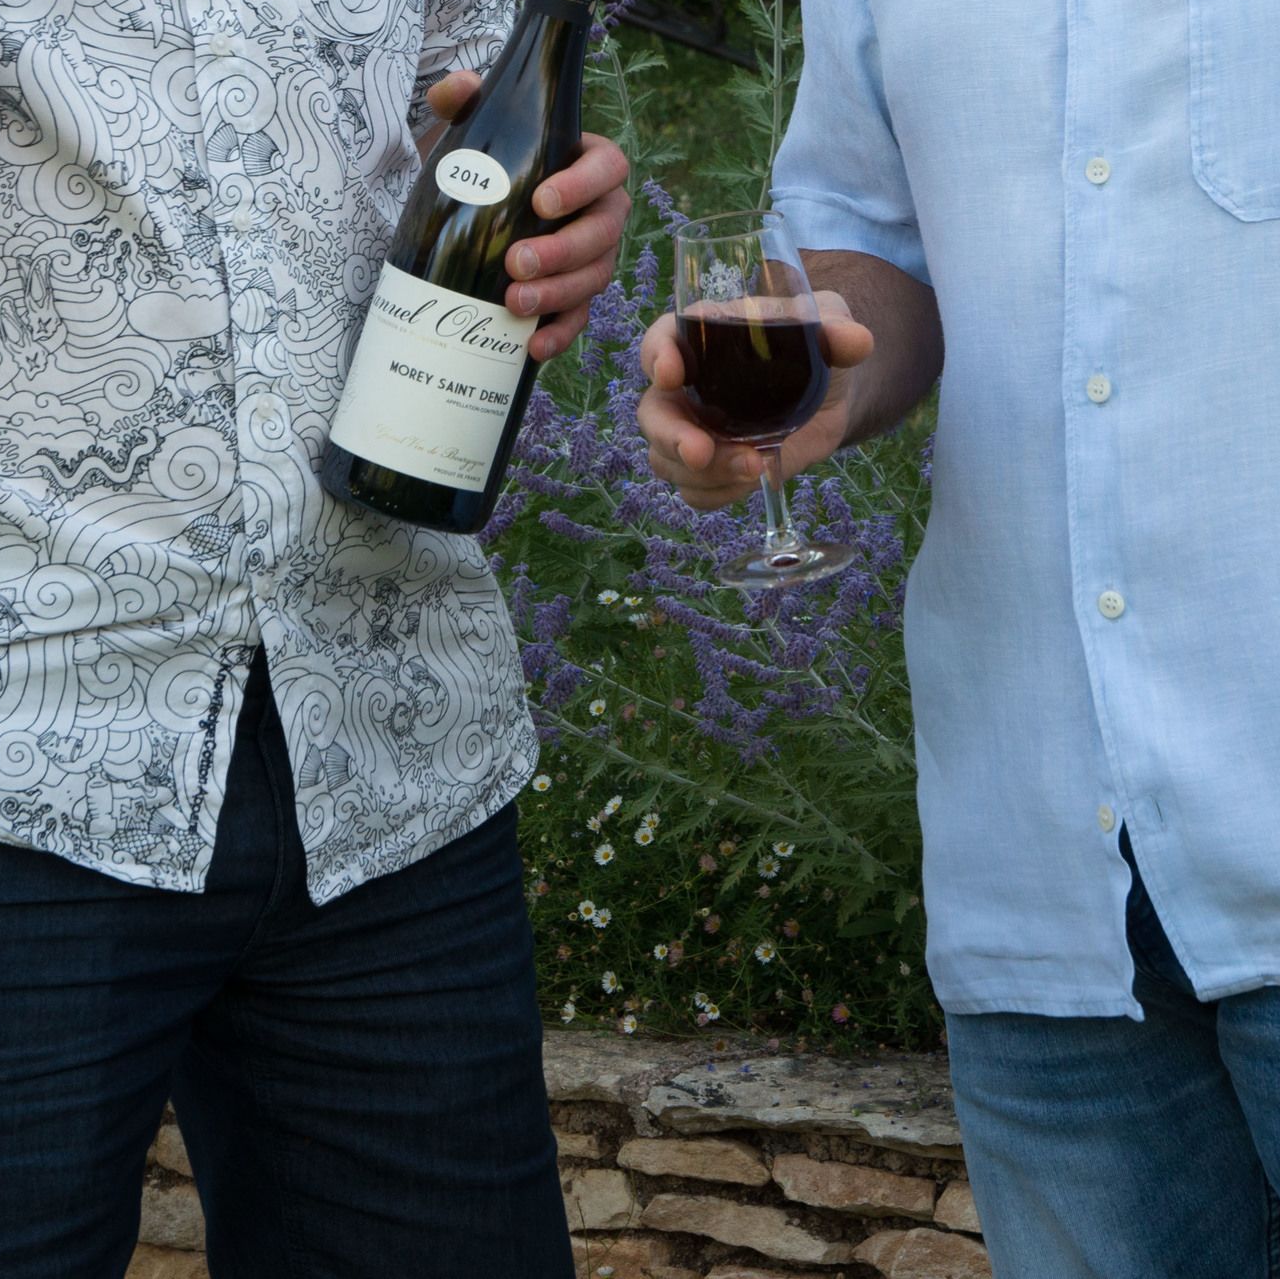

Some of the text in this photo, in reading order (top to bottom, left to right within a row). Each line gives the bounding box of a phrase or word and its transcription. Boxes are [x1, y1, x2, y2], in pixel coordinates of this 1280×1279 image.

[449, 166, 490, 190] 2014
[373, 295, 438, 324] anuel
[435, 303, 524, 356] Olivier
[389, 360, 510, 406] MOREY SAINT DENIS
[199, 664, 232, 739] Knowledge
[200, 739, 217, 785] Cotton
